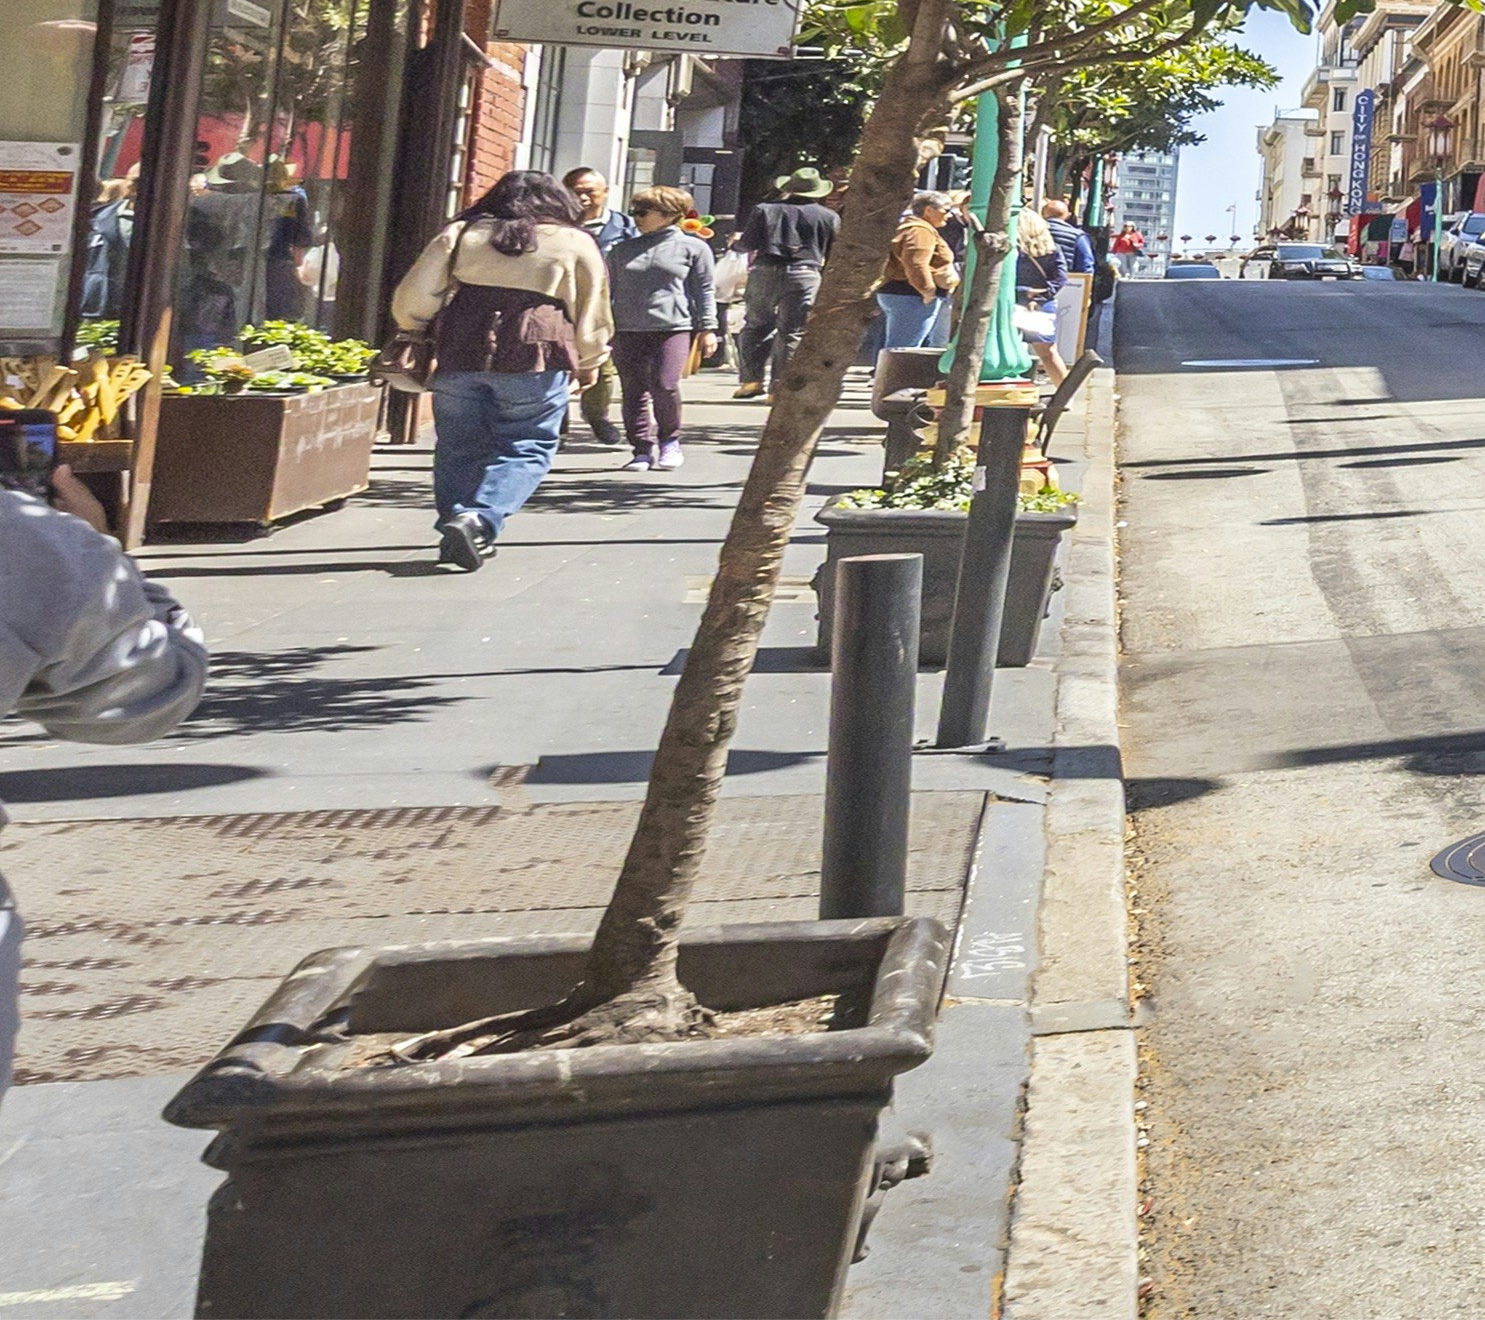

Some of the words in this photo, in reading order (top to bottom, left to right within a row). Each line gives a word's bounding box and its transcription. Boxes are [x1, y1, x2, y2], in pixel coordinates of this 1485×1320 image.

[577, 0, 721, 27] Collection
[576, 25, 642, 39] LOWER
[651, 29, 713, 43] LEVEL
[1356, 95, 1369, 133] CITY
[1351, 143, 1367, 179] HONG
[1349, 181, 1363, 215] KONG
